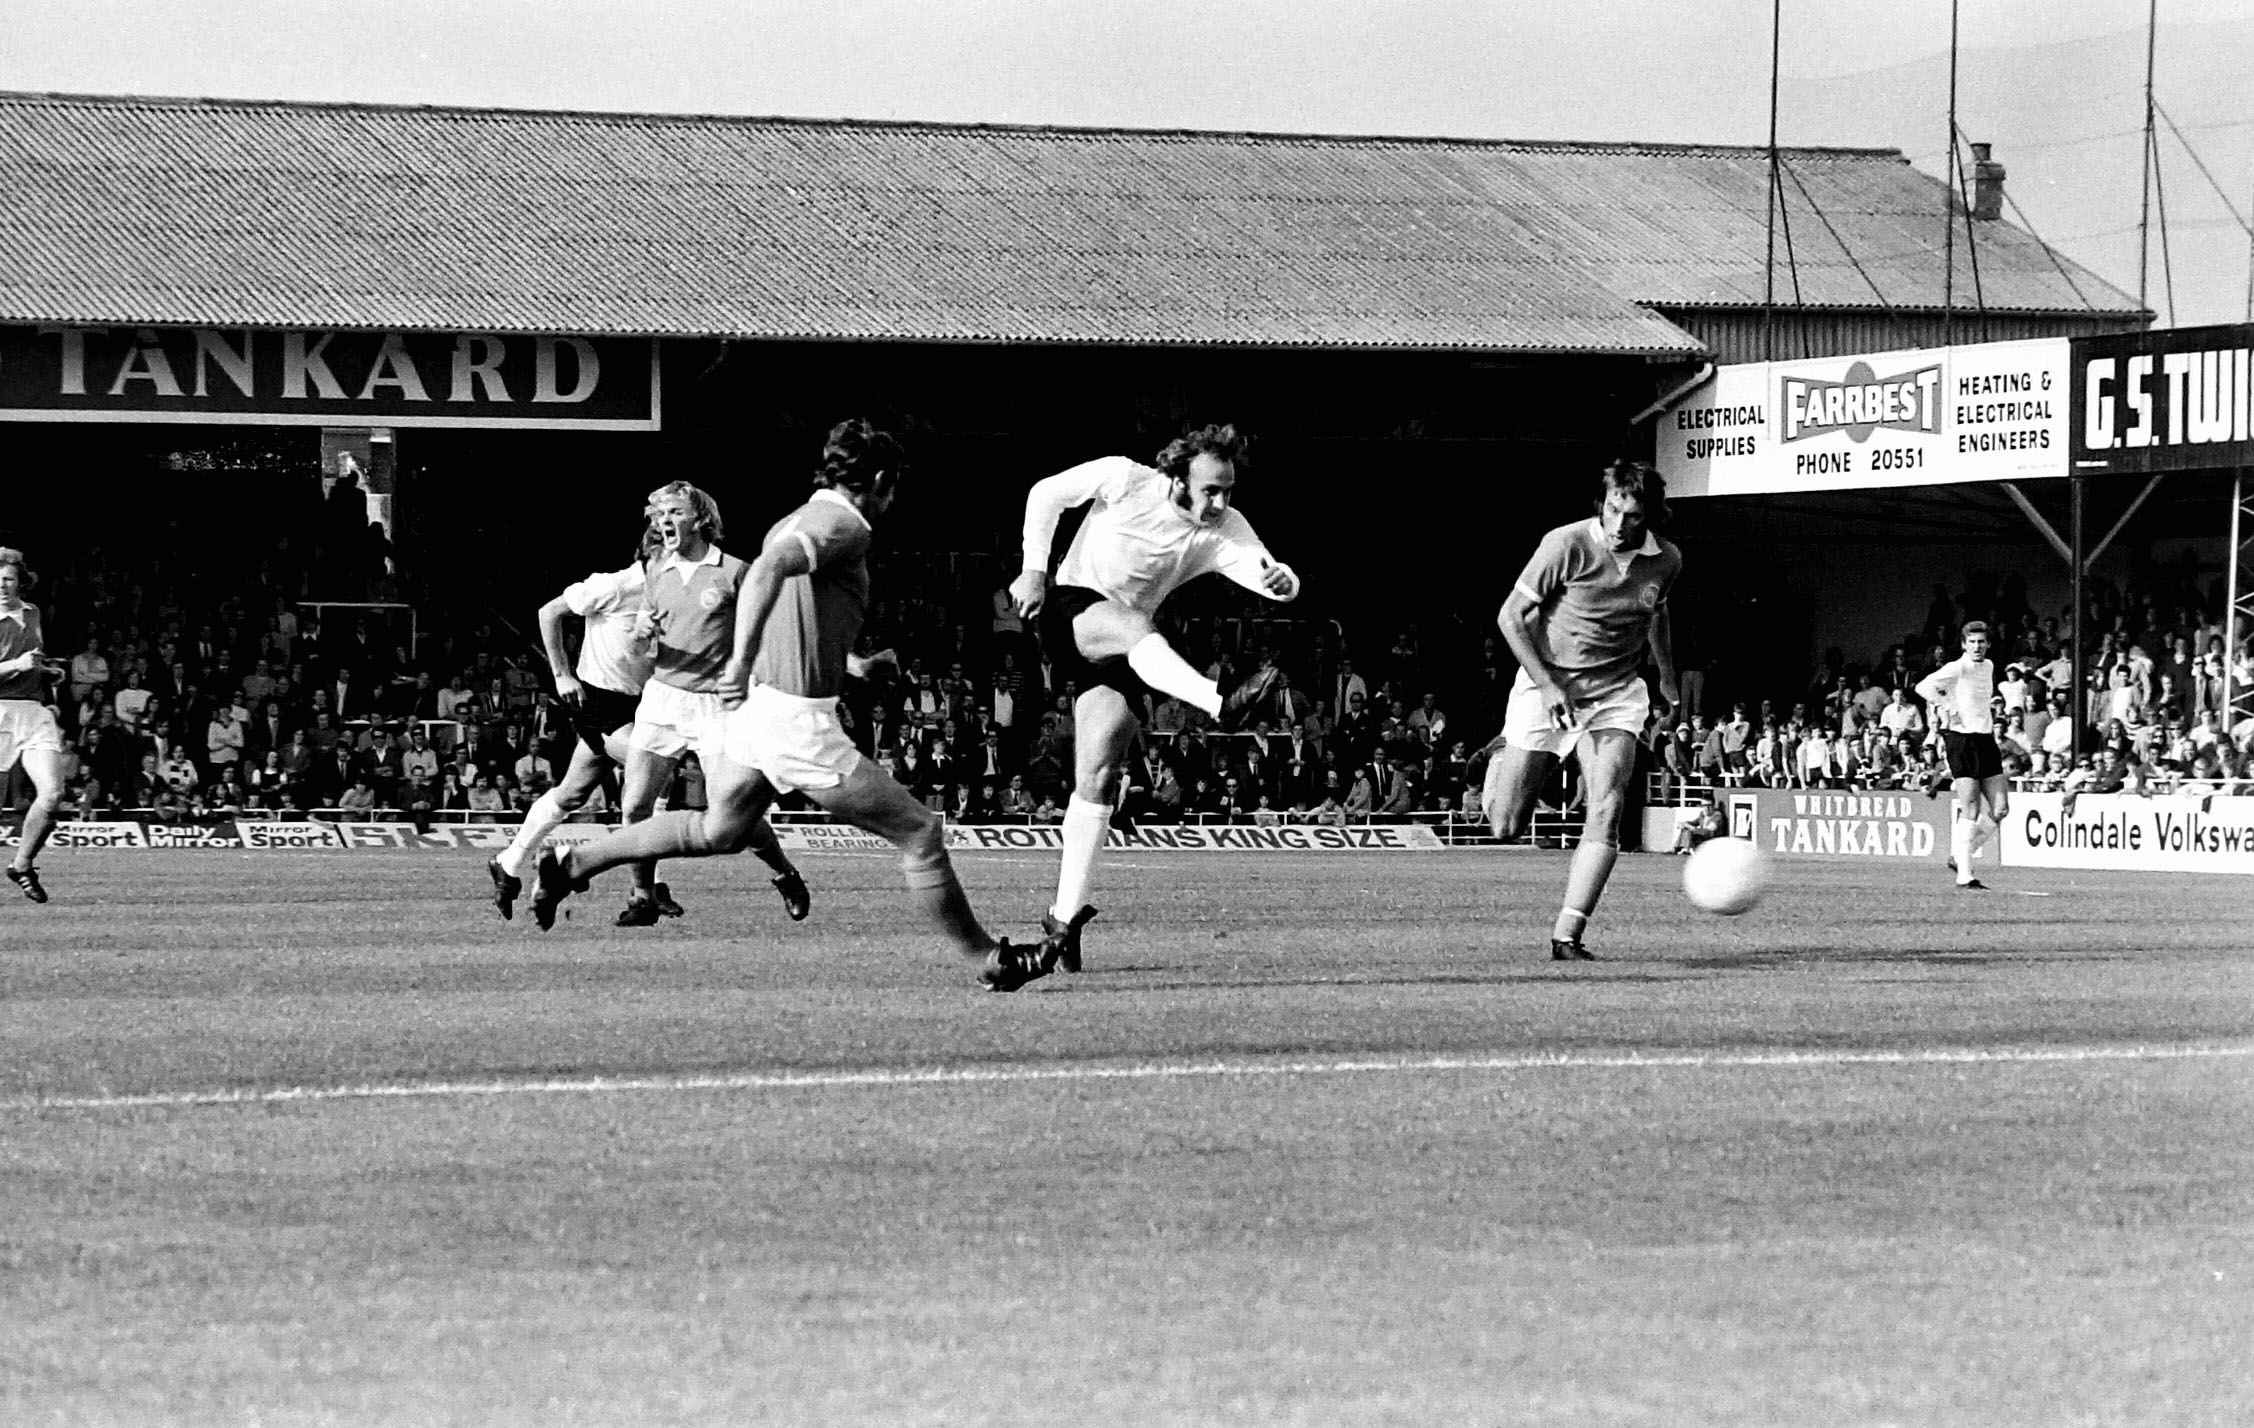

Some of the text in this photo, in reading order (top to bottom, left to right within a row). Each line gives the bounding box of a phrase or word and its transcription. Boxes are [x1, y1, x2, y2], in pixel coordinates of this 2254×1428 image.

[37, 325, 600, 402] TANKARD
[1959, 370, 2052, 396] HEATING &
[1786, 368, 1938, 439] FARRBEST
[2085, 347, 2254, 450] G.S.TWI
[1677, 405, 1765, 430] ELECTRICAL
[1957, 400, 2052, 425] ELECTRICAL
[1686, 436, 1755, 460] SUPPLIES
[1958, 429, 2050, 453] ENGINEERS
[1796, 448, 1923, 475] PHONE 20551
[1794, 795, 1912, 817] WHITBREAD
[52, 832, 138, 848] Sport
[149, 825, 216, 838] Daily
[251, 832, 334, 848] Sport
[1207, 828, 1311, 849] KING
[1313, 829, 1407, 848] SIZE
[1771, 818, 1935, 857] TANKARD
[2025, 809, 2142, 850] Colindale
[149, 836, 240, 848] Mirror
[807, 839, 897, 848] BEARING
